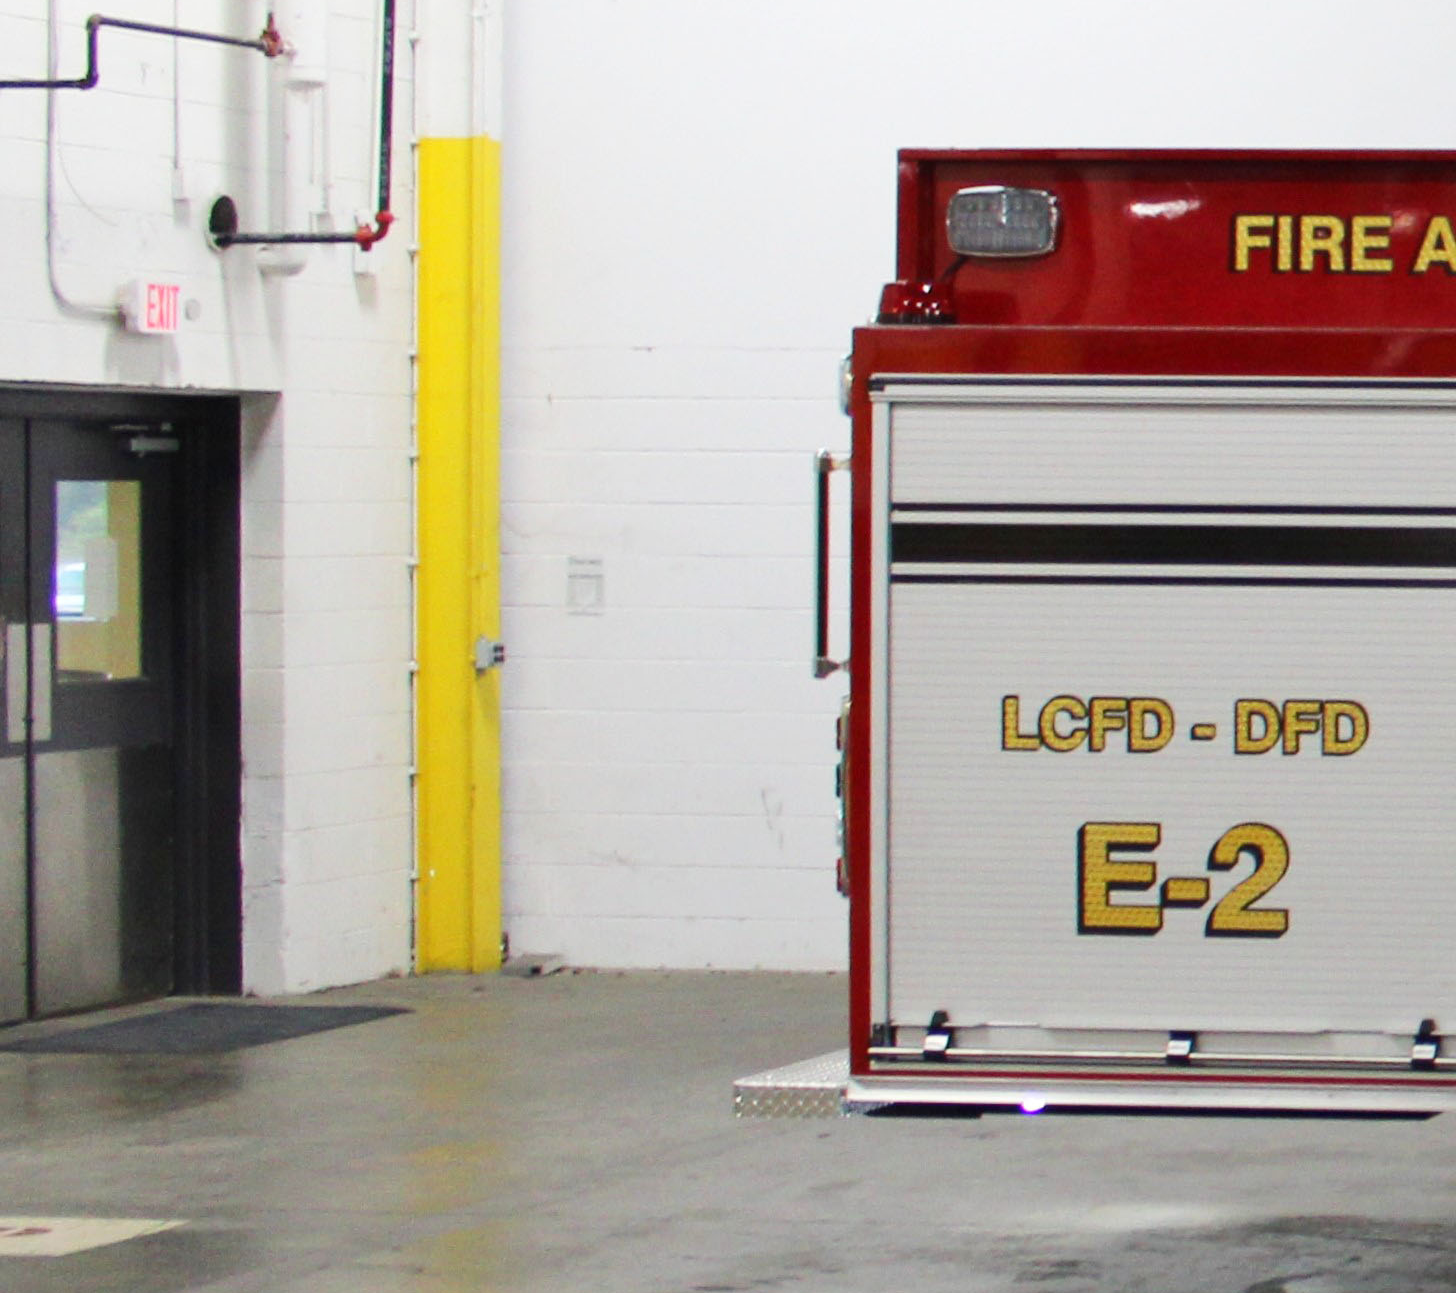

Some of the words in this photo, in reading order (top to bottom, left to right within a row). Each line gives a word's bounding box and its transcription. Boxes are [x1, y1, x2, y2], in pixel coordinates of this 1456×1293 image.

[1232, 213, 1394, 273] FIRE
[147, 284, 179, 330] EXIT
[1002, 694, 1175, 753] LCFD
[1234, 698, 1370, 756] DFD
[1077, 821, 1291, 938] E-2
